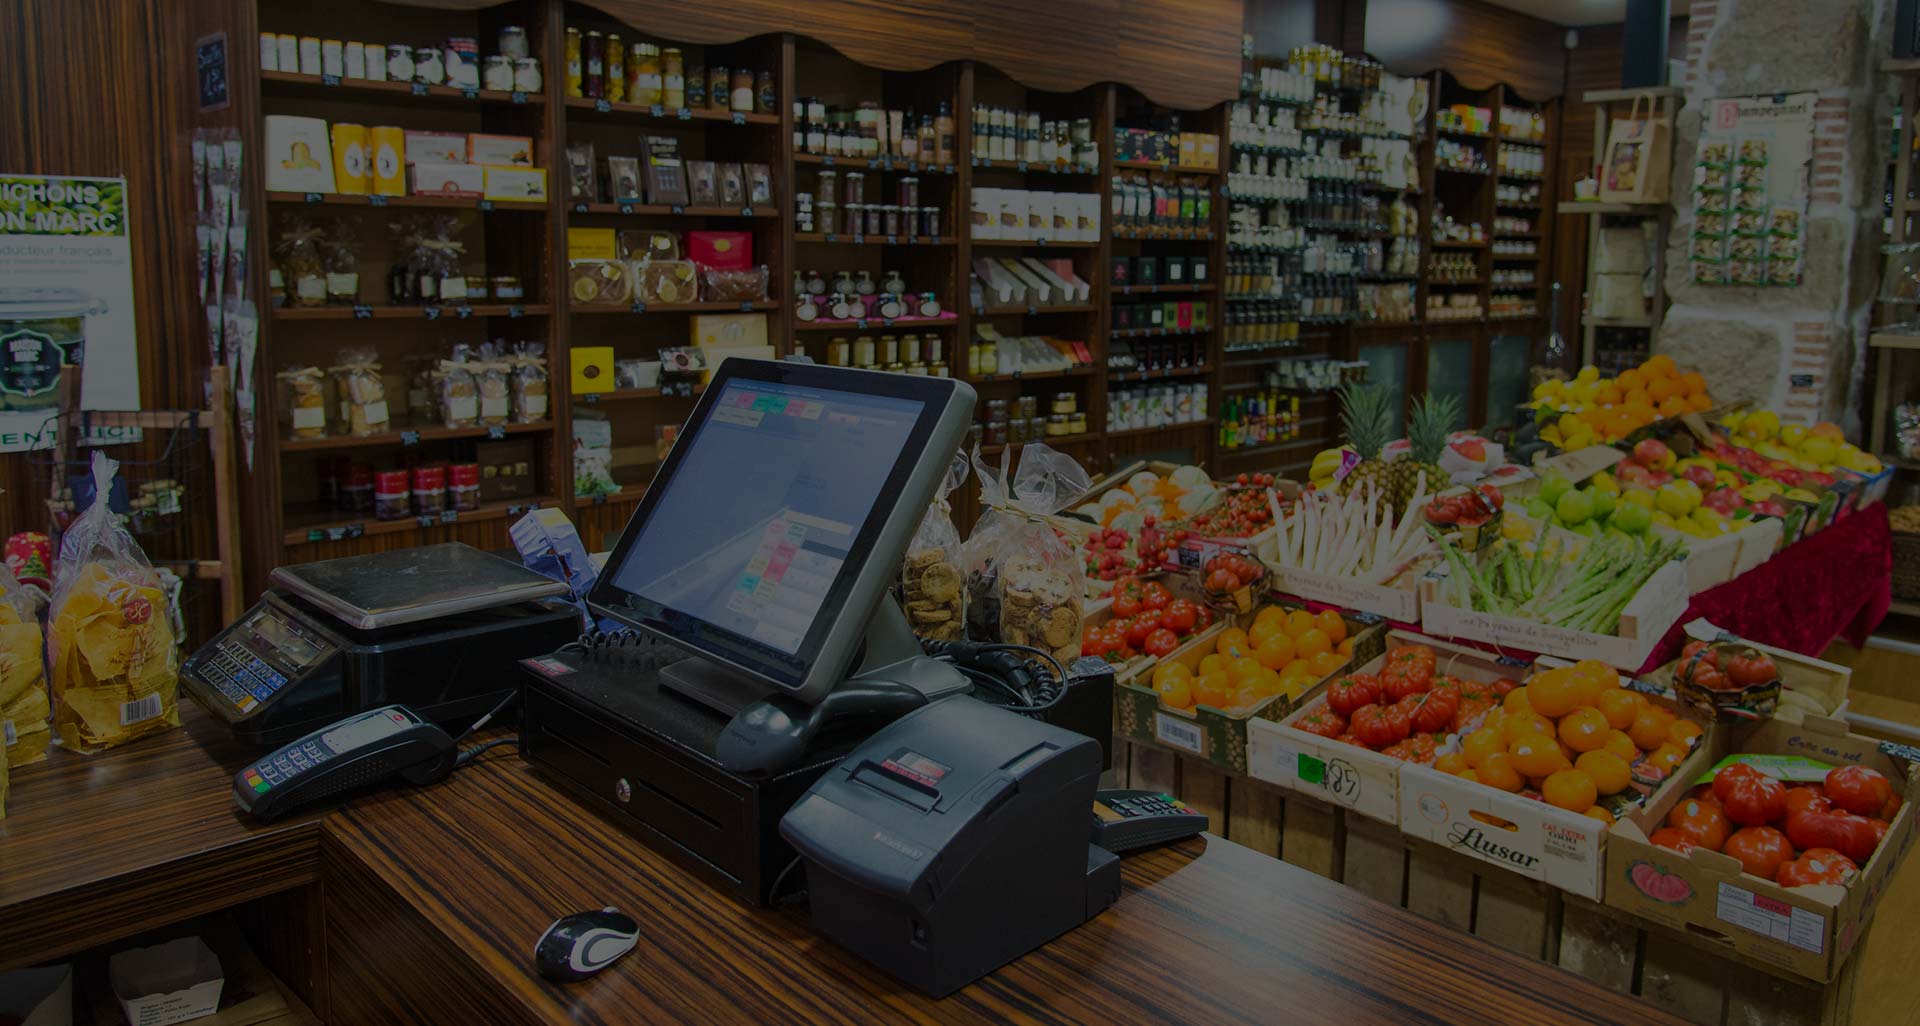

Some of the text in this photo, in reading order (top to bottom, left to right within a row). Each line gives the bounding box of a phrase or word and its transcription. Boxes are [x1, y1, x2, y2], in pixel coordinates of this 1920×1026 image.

[0, 183, 100, 204] ICHONS
[35, 211, 117, 233] MARC
[1447, 822, 1540, 868] Llusar
